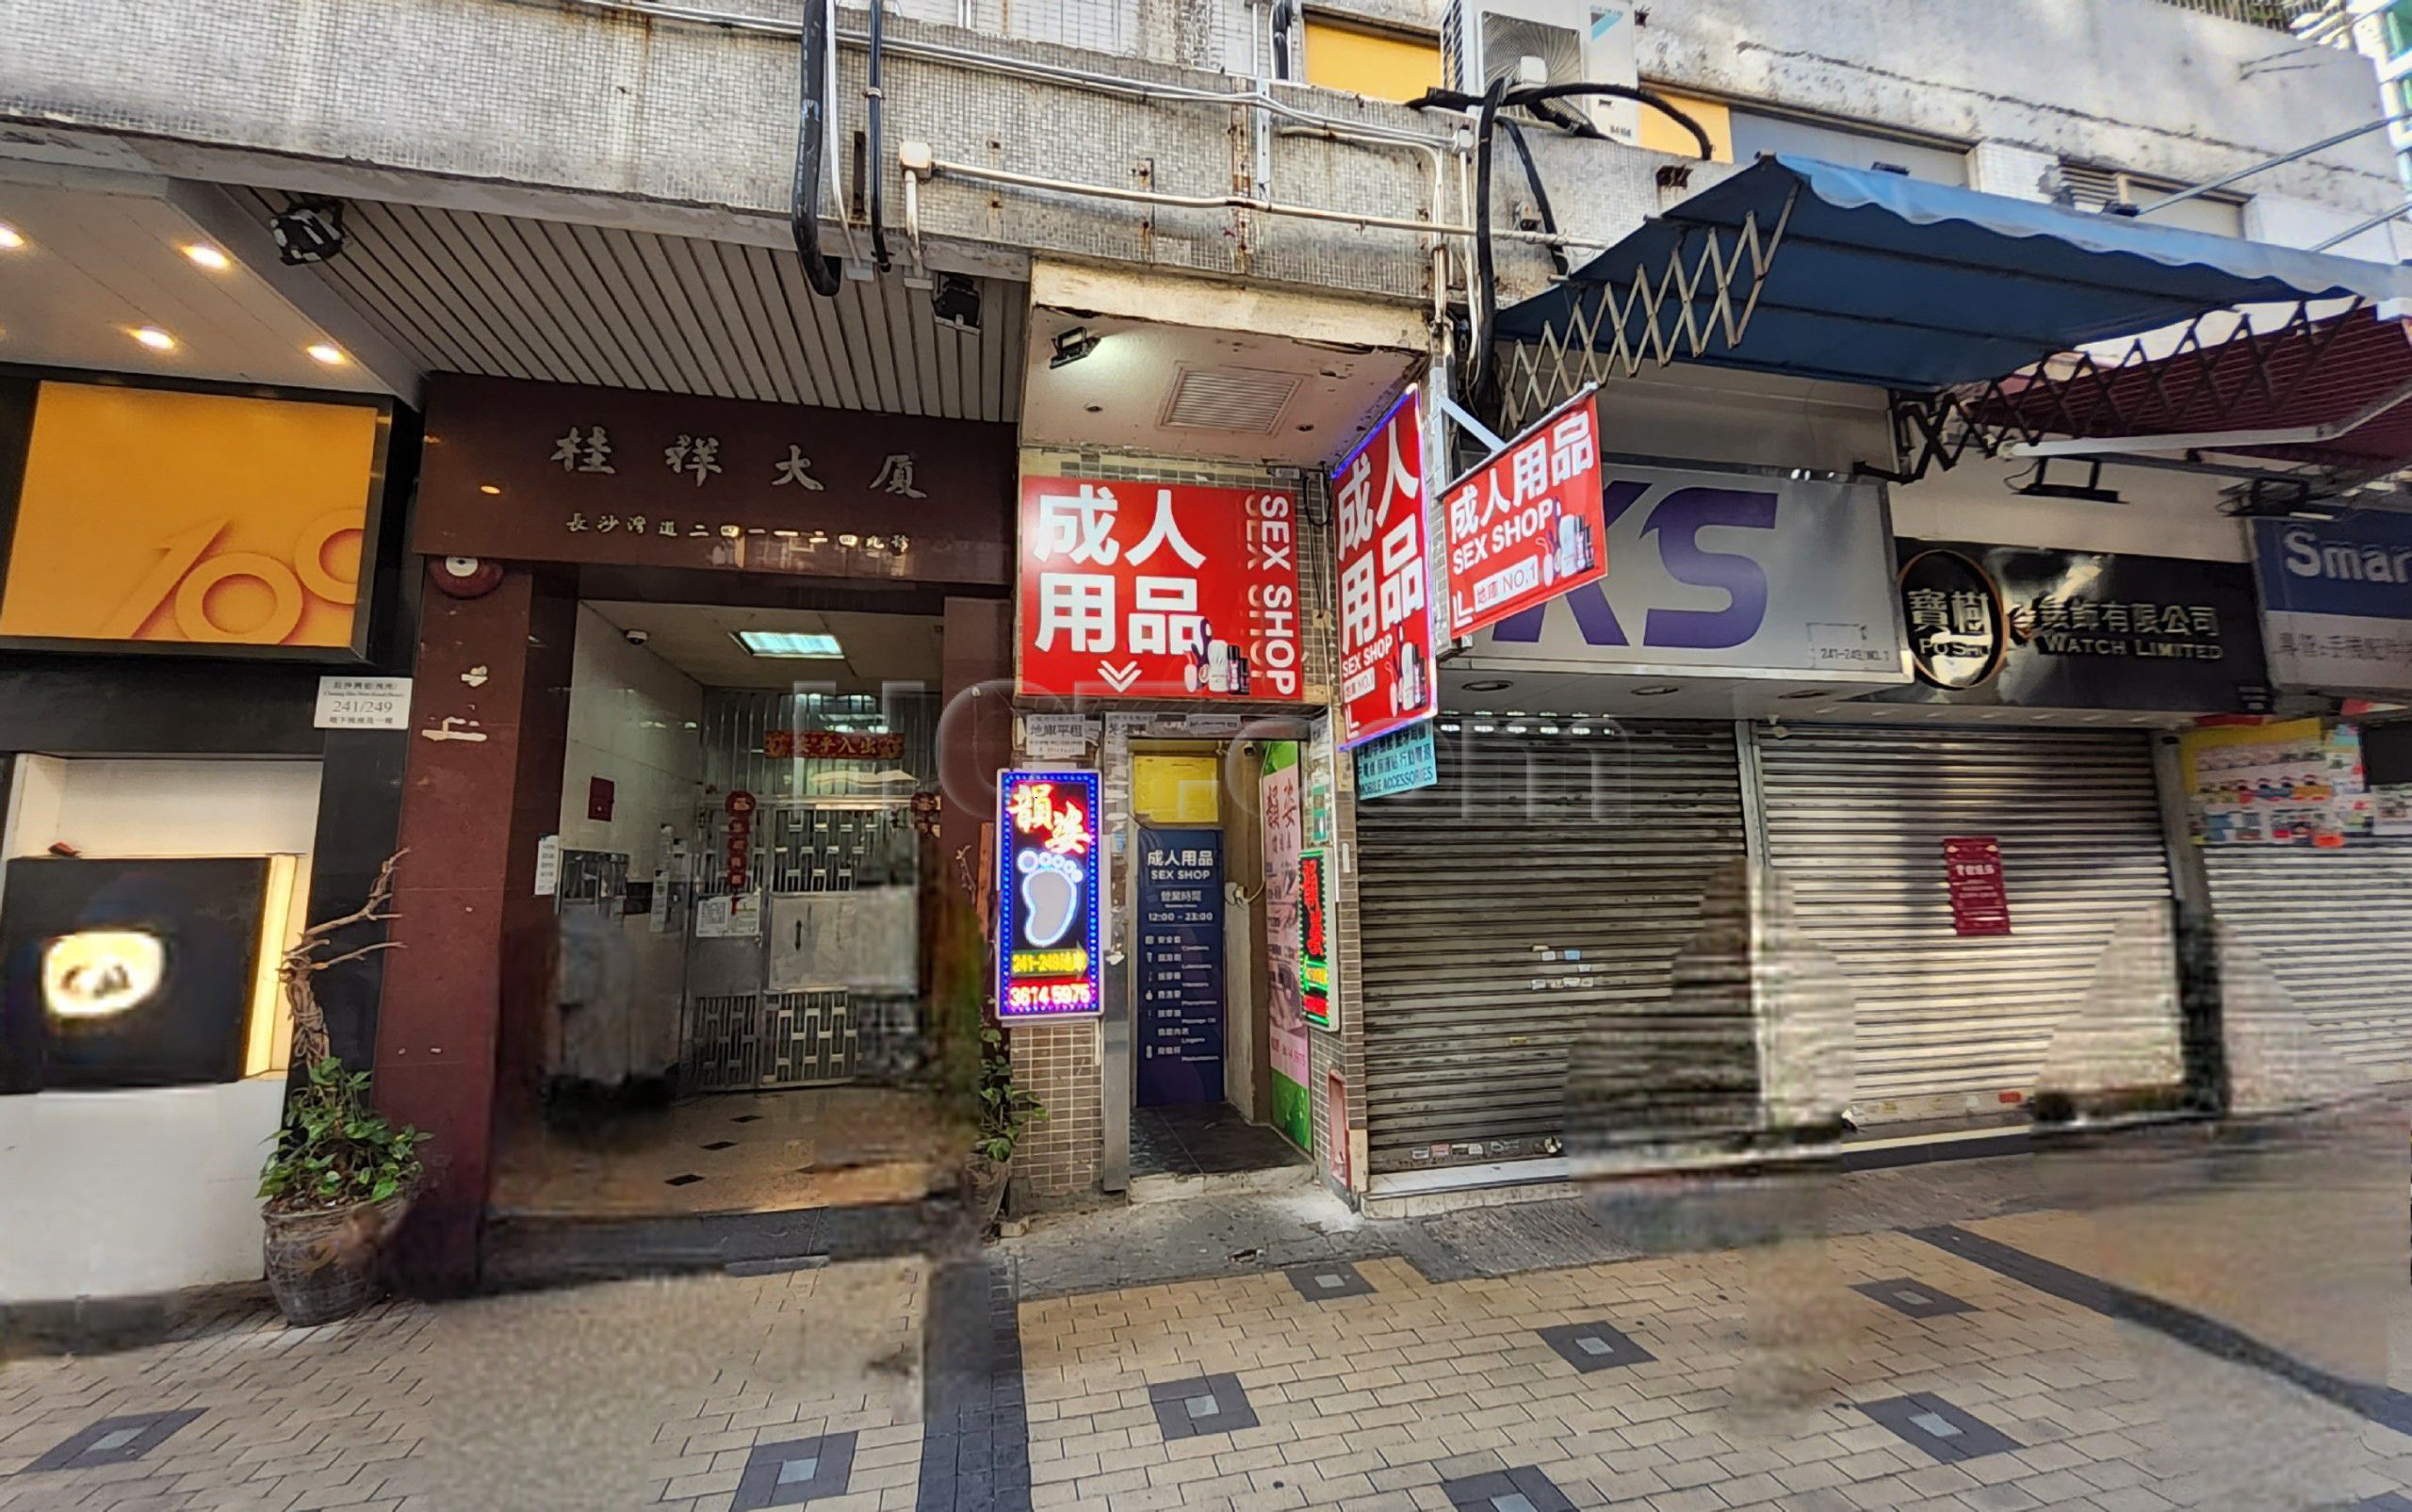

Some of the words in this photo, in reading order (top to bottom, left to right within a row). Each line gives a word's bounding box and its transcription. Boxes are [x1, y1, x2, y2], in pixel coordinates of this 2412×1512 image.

[549, 425, 928, 498] 桂祥大廈
[1338, 416, 1420, 562] 成人
[1450, 411, 1594, 545] 成人用品
[1033, 483, 1207, 570] 成人
[1260, 494, 1292, 571] SEX
[1453, 533, 1488, 575] SEX
[1491, 498, 1553, 554] SHOP
[1034, 572, 1208, 656] 用品
[1341, 512, 1426, 656] 用品
[1263, 583, 1296, 695] SHOP
[1342, 652, 1362, 678] SEX
[1363, 632, 1393, 667] SHOP
[2039, 632, 2127, 657] WATCH
[2134, 640, 2224, 659] LIMITED
[333, 700, 393, 713] 241/249
[1147, 849, 1214, 867] 成人用品
[1150, 870, 1175, 881] SEX
[1177, 870, 1211, 880] SHOP
[1148, 912, 1175, 921] 12:00
